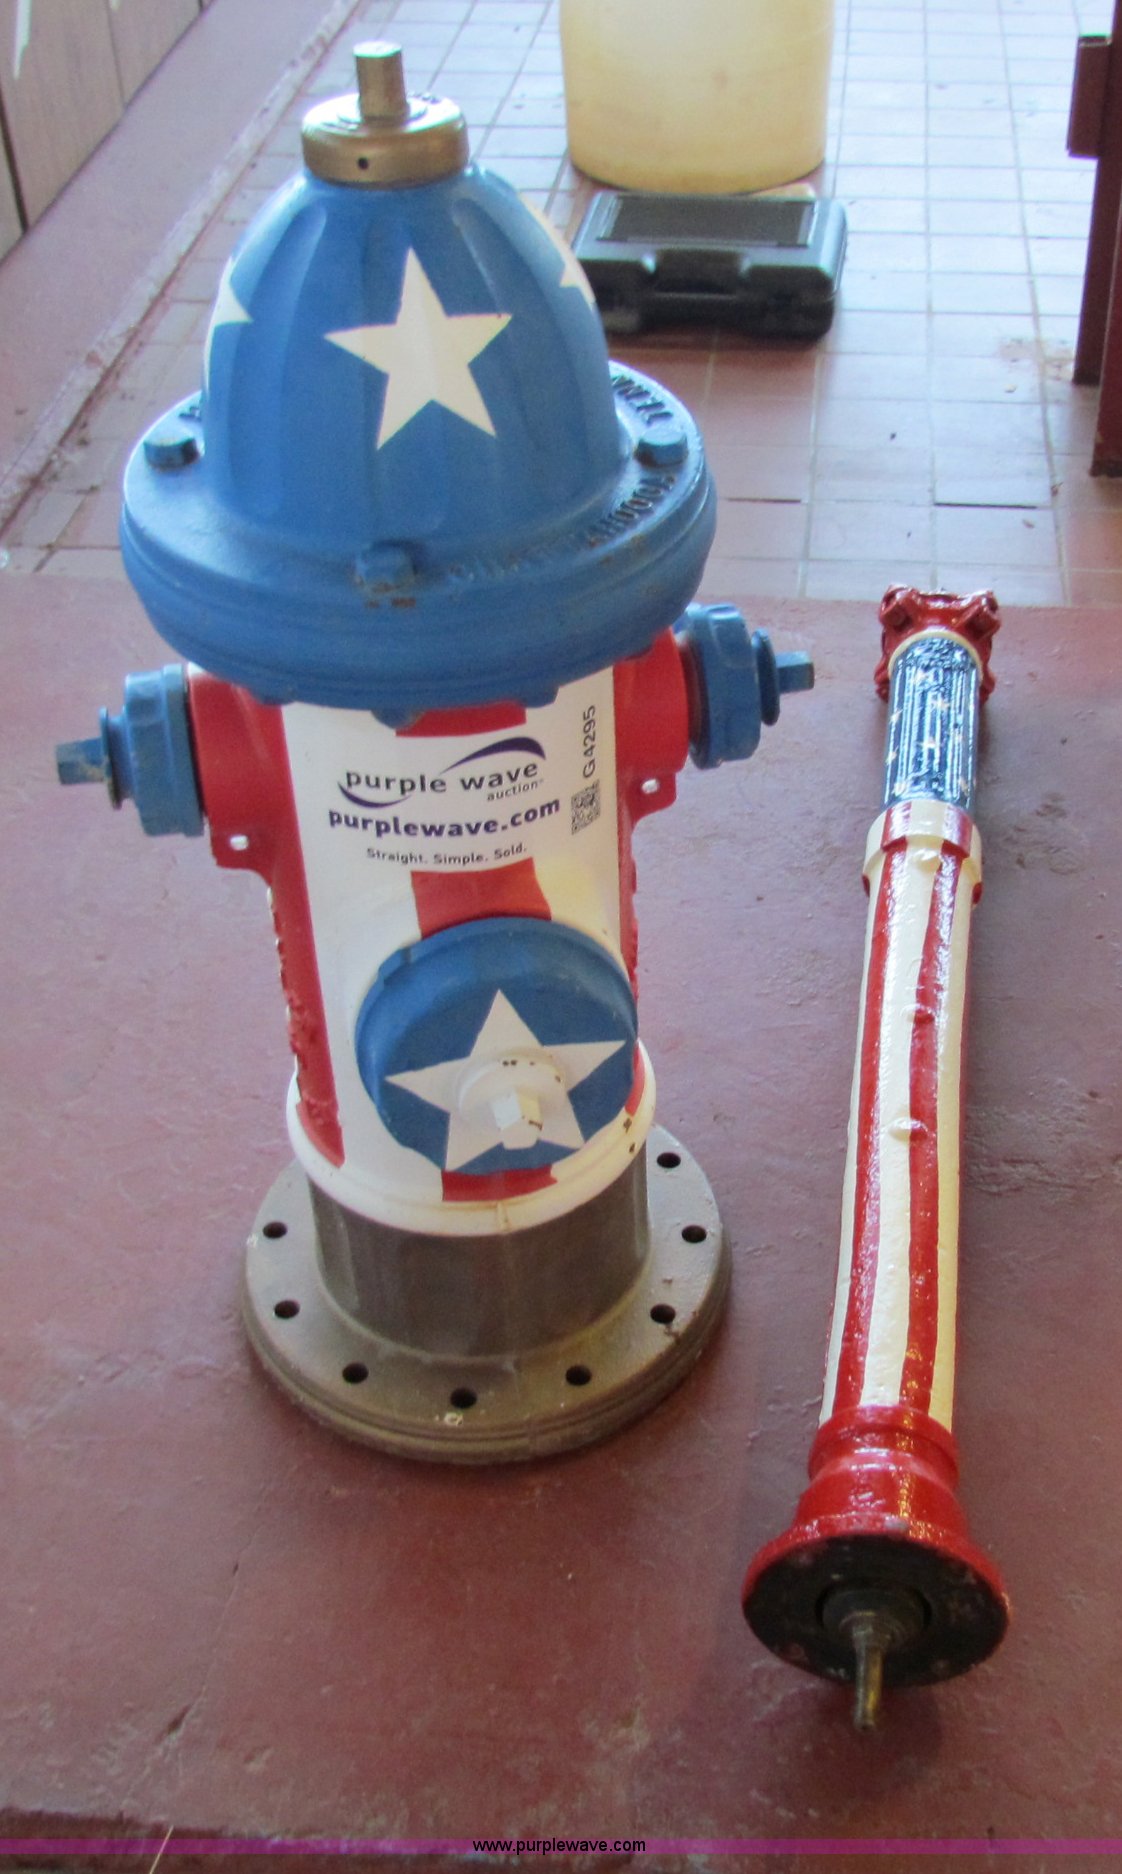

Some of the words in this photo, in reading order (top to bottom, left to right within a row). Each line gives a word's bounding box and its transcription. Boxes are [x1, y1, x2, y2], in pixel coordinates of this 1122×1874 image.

[583, 705, 596, 778] G4295
[346, 771, 447, 796] purple
[460, 763, 538, 791] wave
[487, 782, 537, 801] auction
[329, 799, 561, 837] purplewave.com
[367, 848, 428, 865] Straight.
[433, 855, 489, 867] Simple.
[494, 843, 527, 859] Sold.
